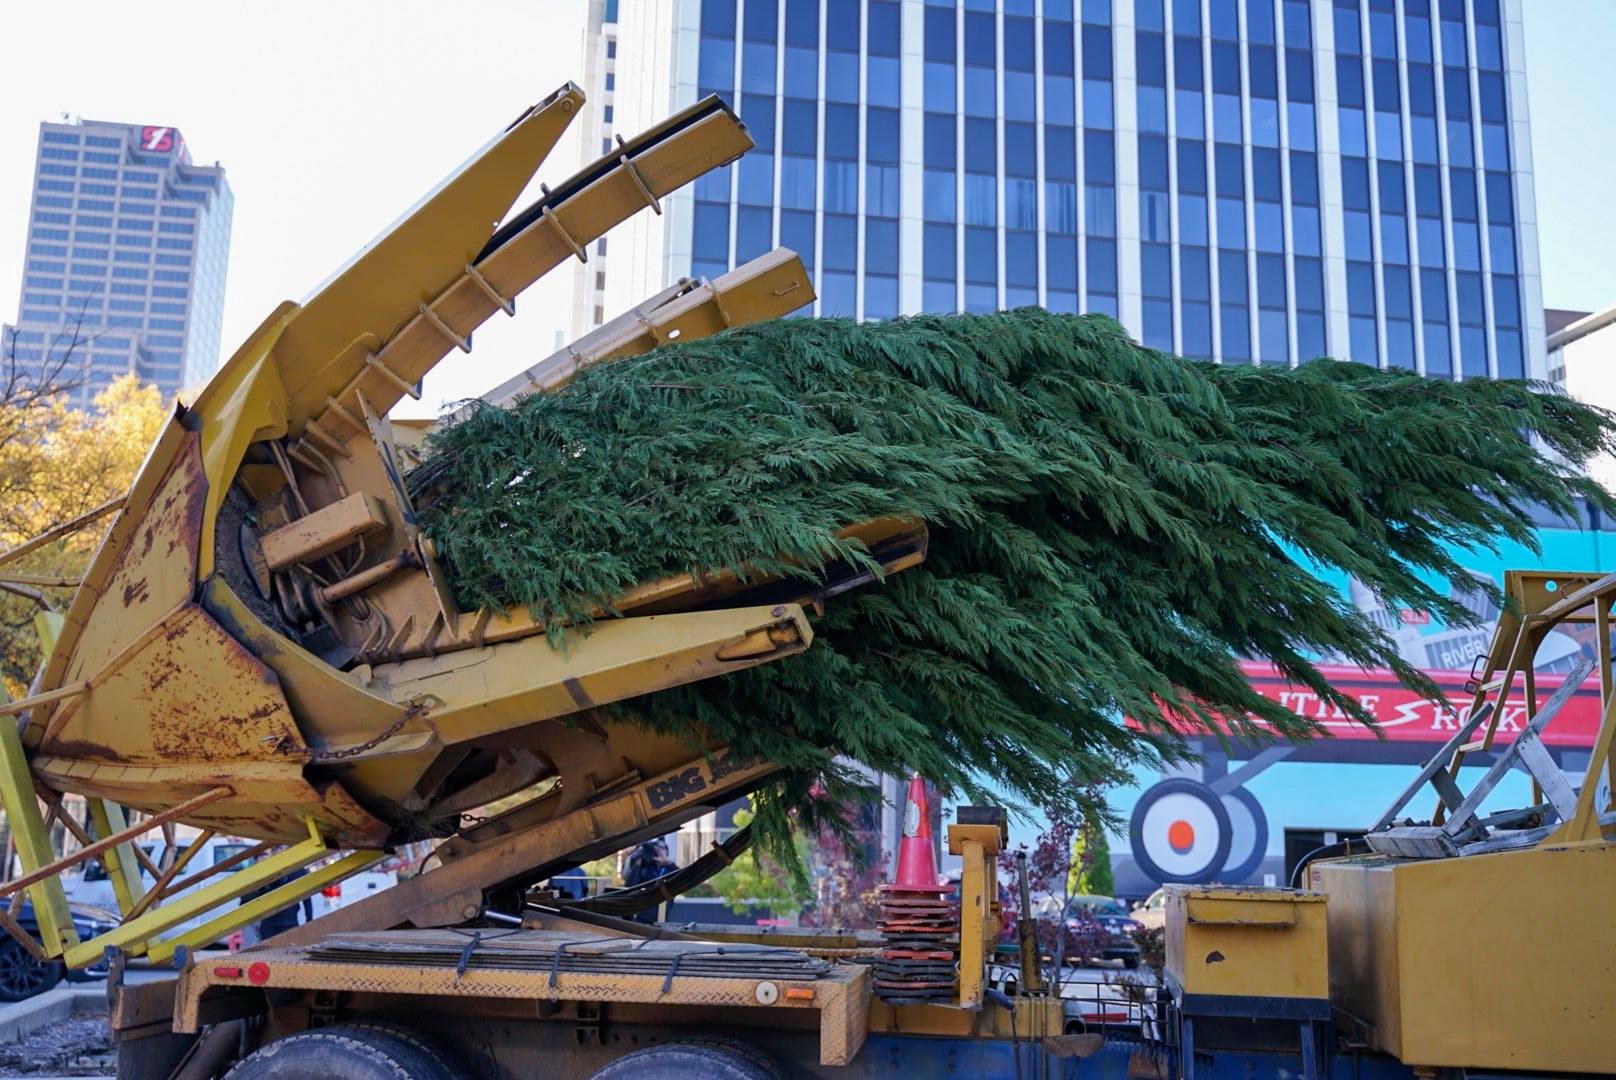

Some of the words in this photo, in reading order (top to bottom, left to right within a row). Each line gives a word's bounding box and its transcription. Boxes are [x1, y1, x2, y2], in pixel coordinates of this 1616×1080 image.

[1441, 638, 1487, 669] RIVER
[1256, 691, 1380, 719] ITTLE
[1431, 705, 1526, 732] ROK
[645, 767, 706, 810] BIG
